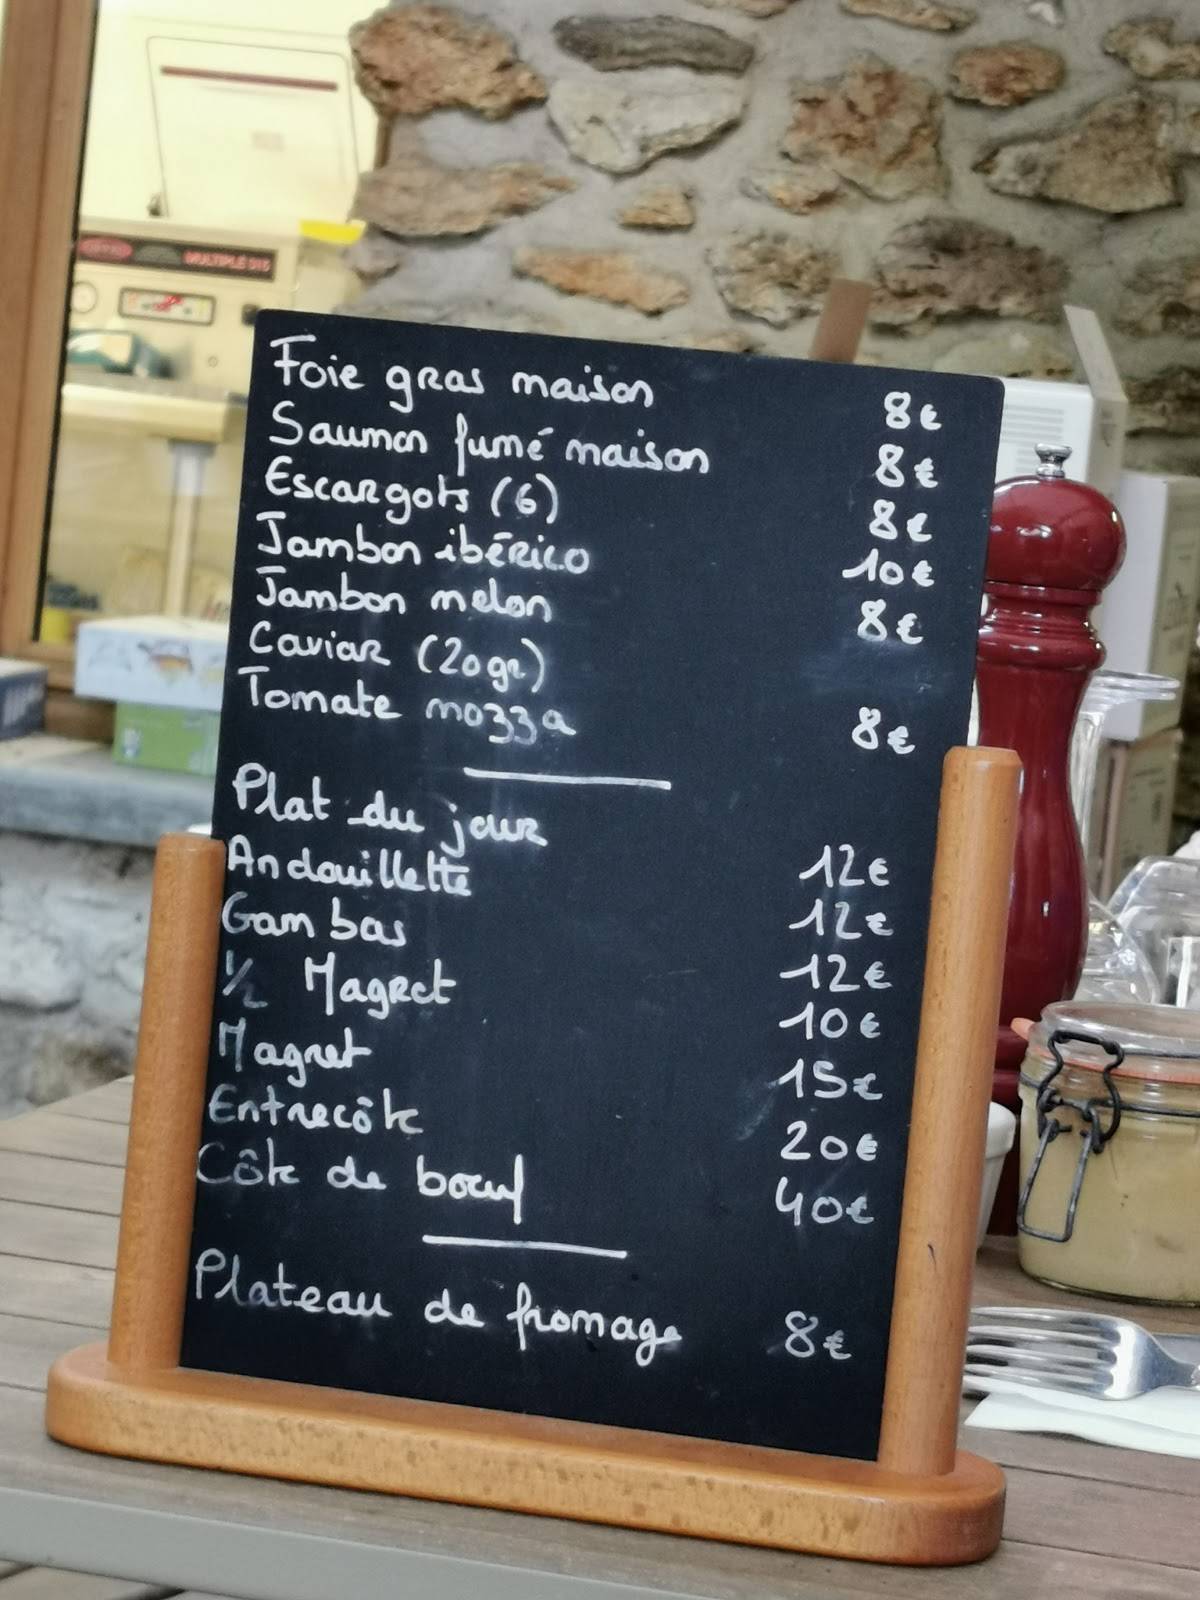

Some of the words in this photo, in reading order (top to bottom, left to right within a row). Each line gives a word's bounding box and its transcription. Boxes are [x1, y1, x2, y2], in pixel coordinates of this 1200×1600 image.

[270, 334, 365, 390] Foie
[386, 365, 485, 414] gras
[512, 365, 654, 408] maison
[269, 400, 428, 454] Saumon
[454, 413, 554, 477] fumé
[565, 428, 710, 474] maison
[265, 455, 469, 525] Escargots
[491, 473, 559, 524] (6)
[256, 511, 422, 565] Jambon
[256, 565, 407, 615] Jambon
[430, 578, 553, 623] melon
[249, 620, 391, 666] Caviar
[238, 666, 402, 721] Tomate
[232, 762, 331, 822] Plat
[347, 790, 425, 834] du
[440, 800, 548, 858] jour
[228, 835, 472, 897] Andouillette
[304, 952, 457, 1020] Magret
[219, 1017, 372, 1088] Magret
[327, 1156, 387, 1190] de
[196, 1248, 392, 1320] Plateau
[424, 1288, 486, 1328] de
[506, 1282, 683, 1368] fromage
